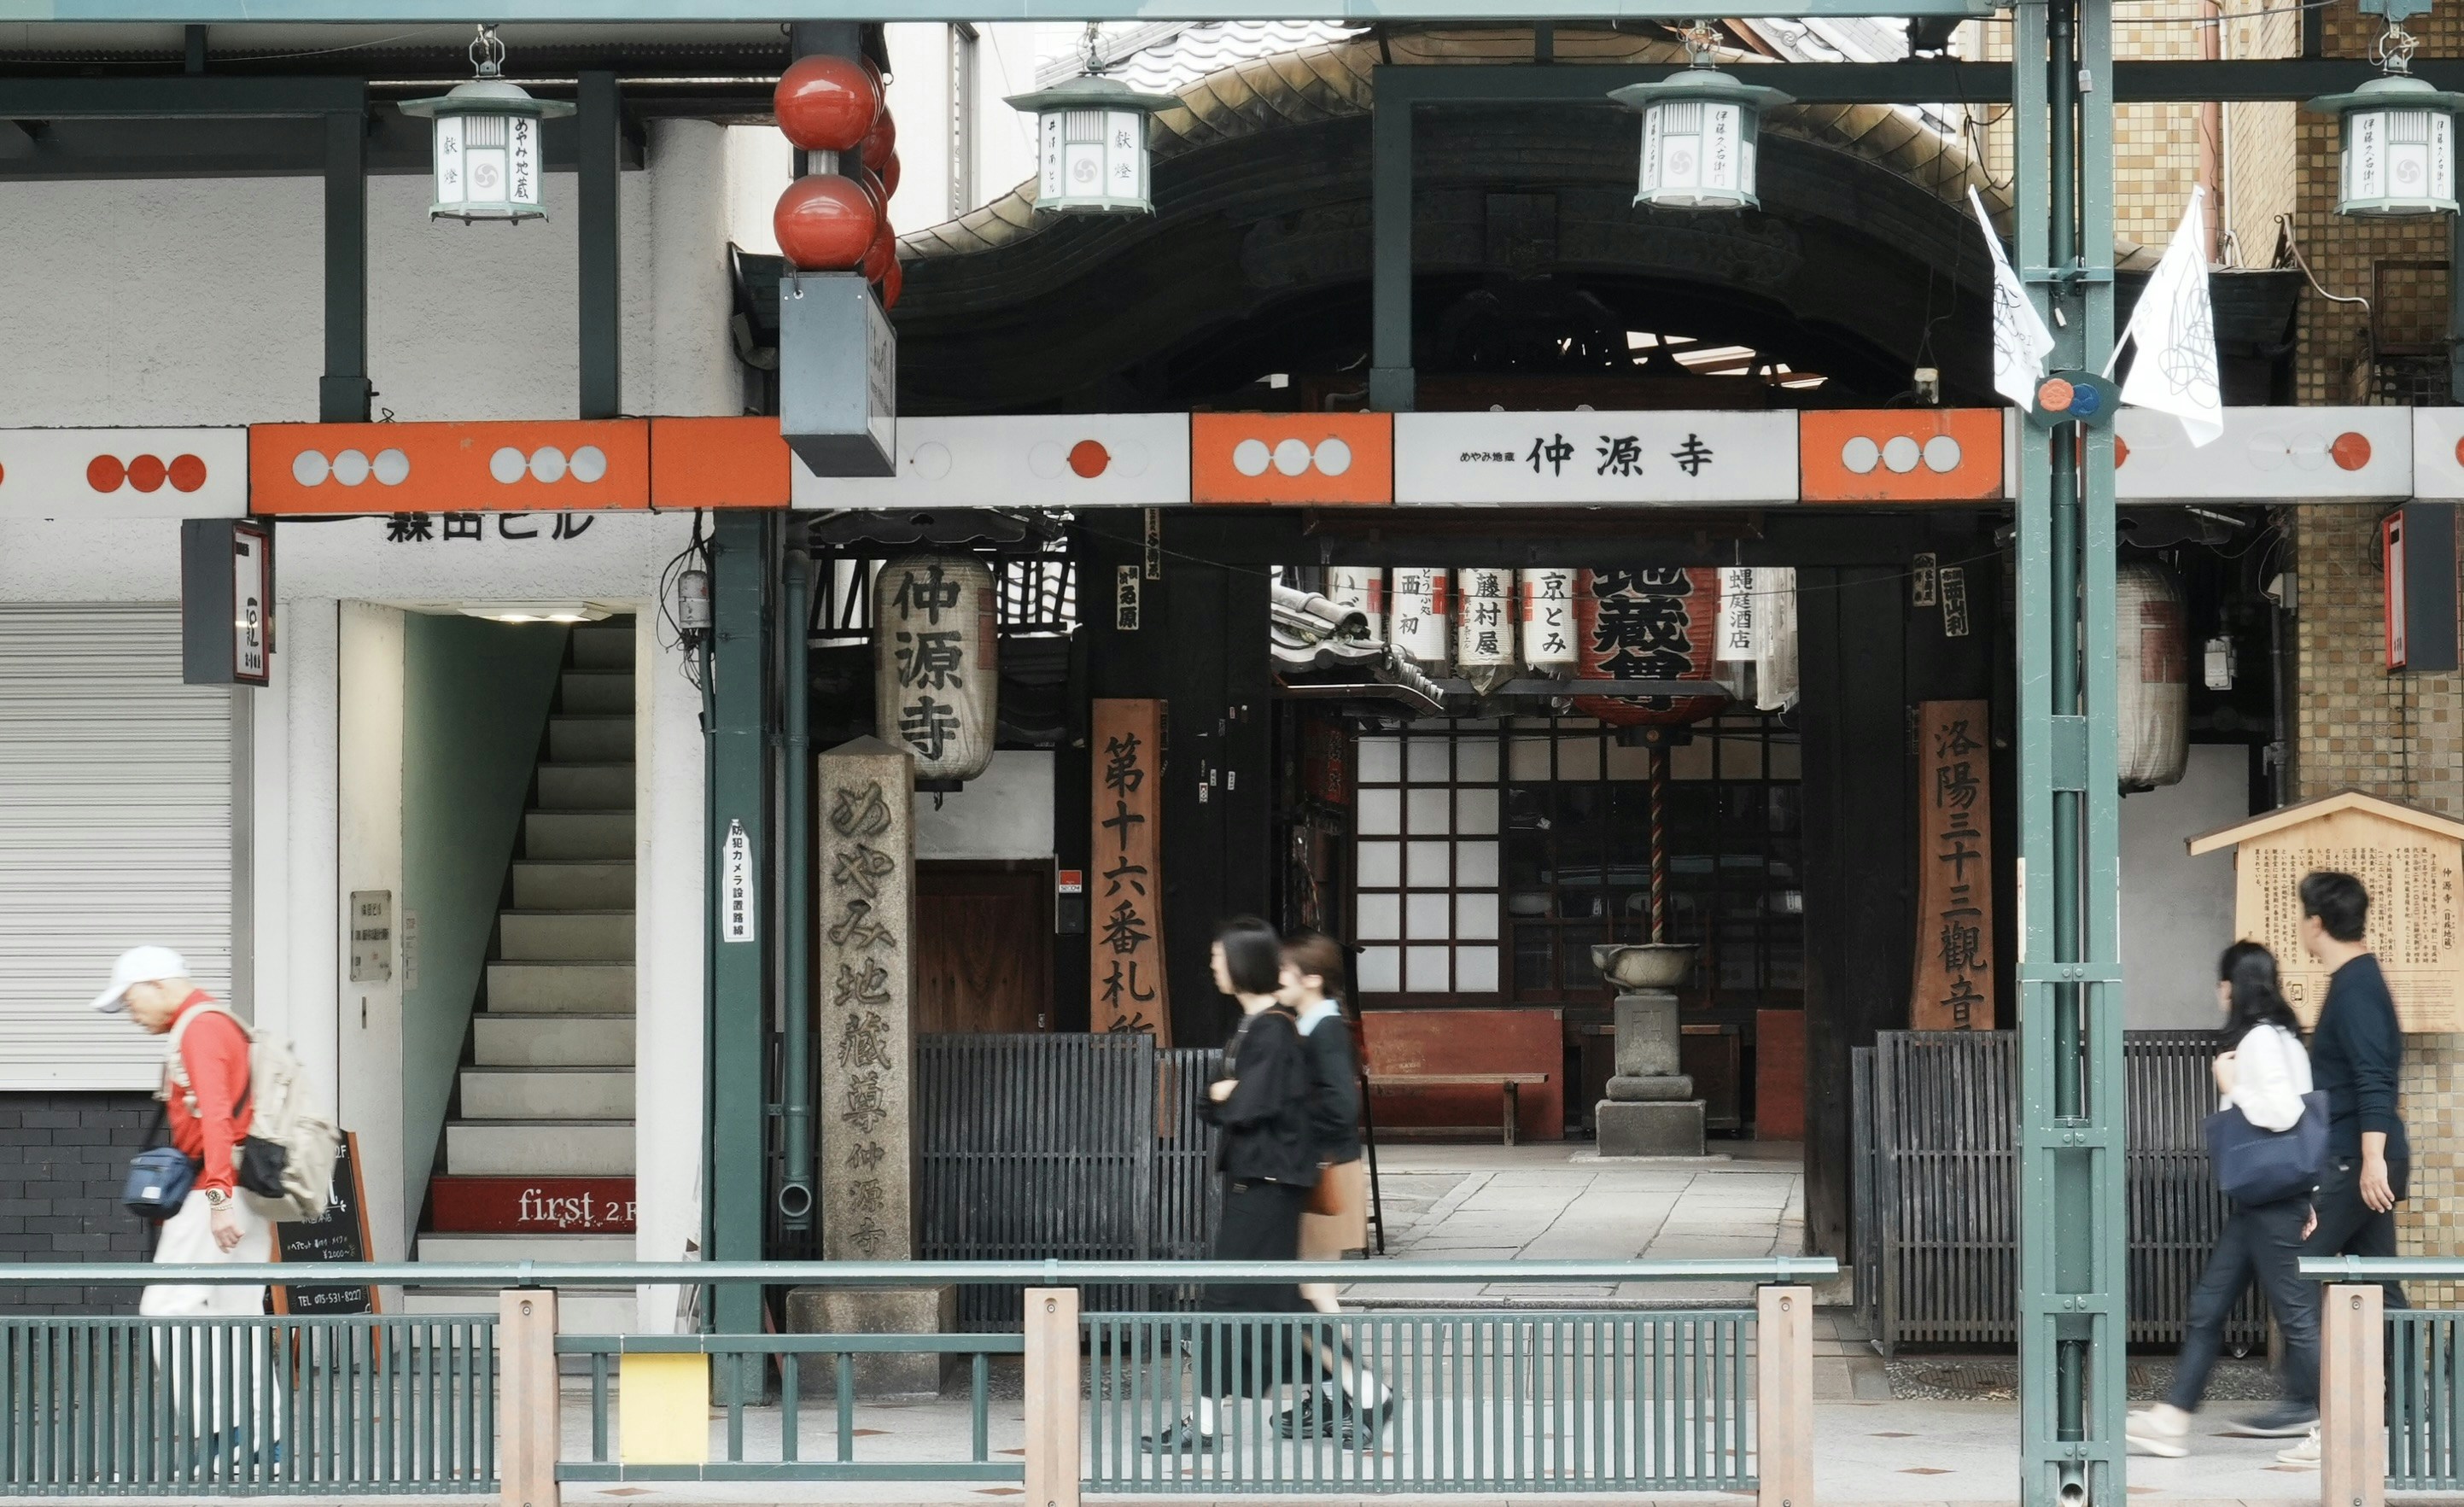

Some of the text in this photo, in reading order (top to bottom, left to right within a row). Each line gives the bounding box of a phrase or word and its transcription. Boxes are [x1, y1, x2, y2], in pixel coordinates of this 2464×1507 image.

[1714, 110, 1728, 186] 伊藤久右衛門
[2363, 118, 2375, 195] 伊藤久右衛門
[1526, 433, 1714, 477] 仲源寺
[1474, 573, 1501, 655] 藤村屋
[1541, 571, 1567, 653] 京とみ
[892, 564, 963, 761] 仲源寺
[732, 825, 744, 936] 防犯カメラ設置路線
[518, 1189, 594, 1222] first
[298, 1288, 362, 1306] TEL 075-531-8227
